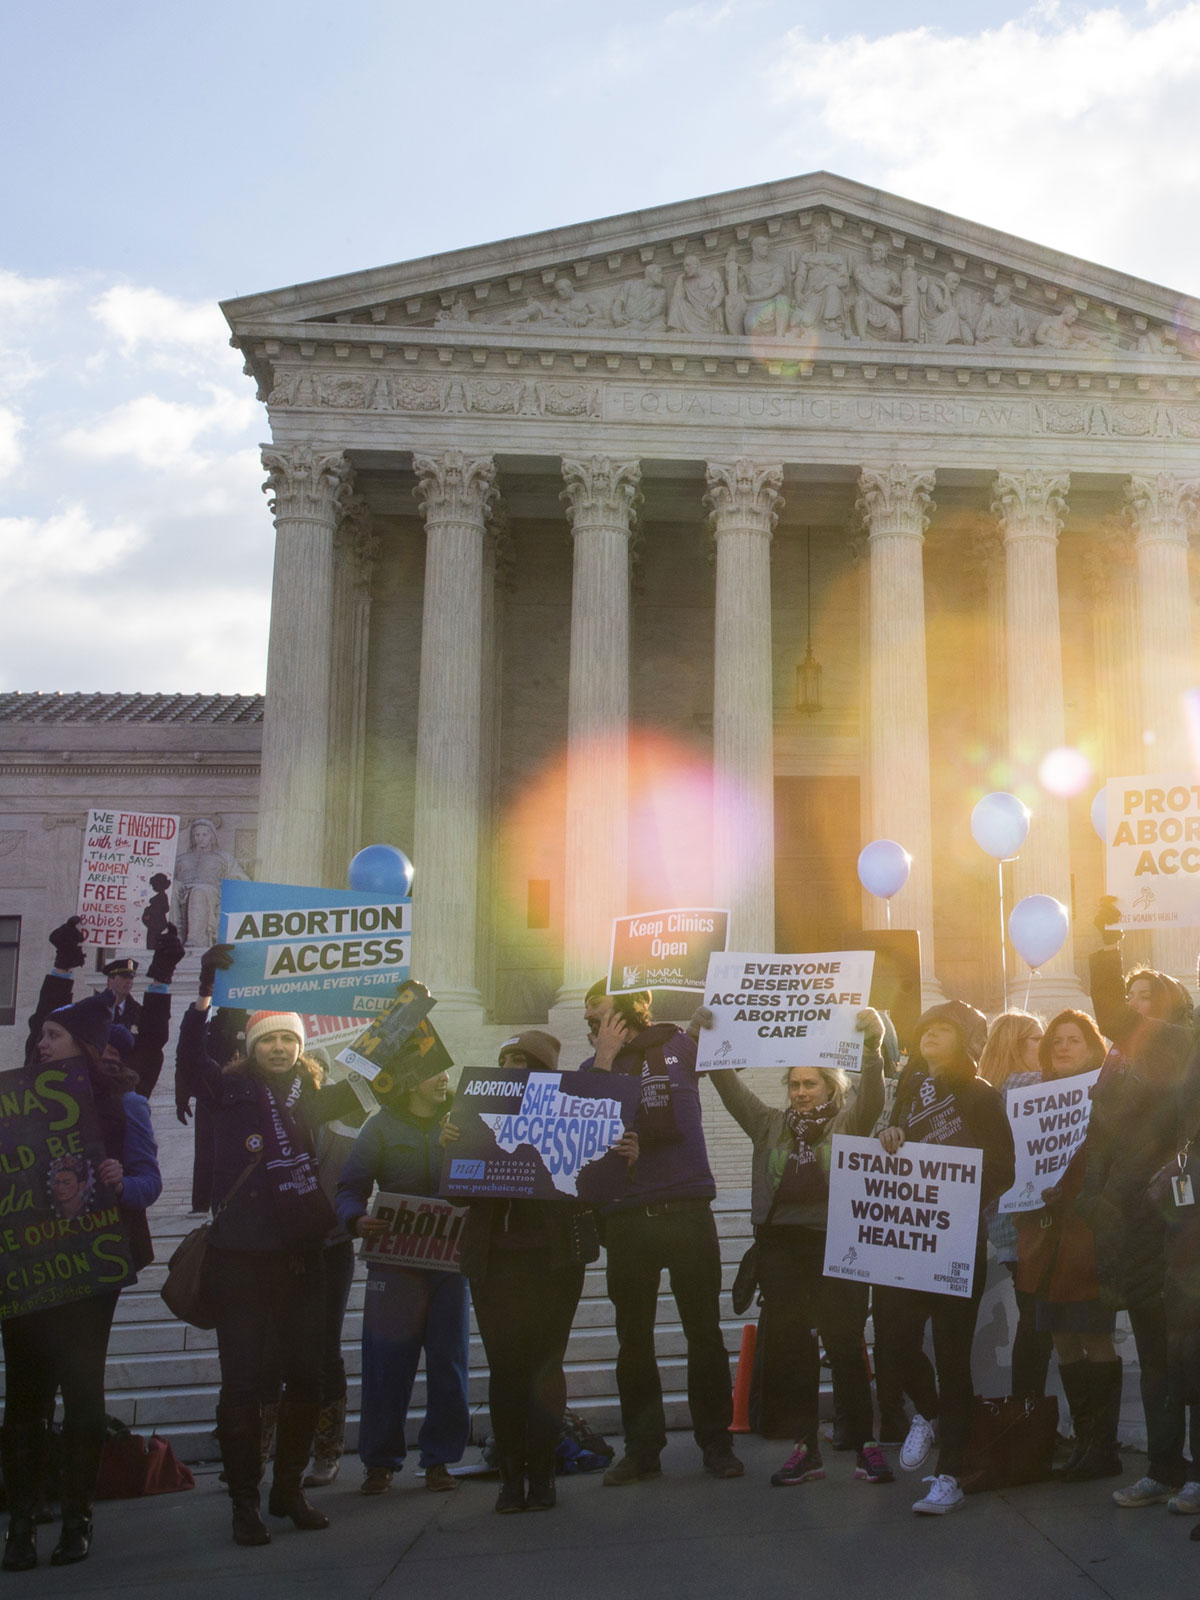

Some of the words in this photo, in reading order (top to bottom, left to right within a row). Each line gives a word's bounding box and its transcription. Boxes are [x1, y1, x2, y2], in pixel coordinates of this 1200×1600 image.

[622, 392, 721, 416] EQUAL
[728, 395, 841, 420] JUSTICE
[856, 401, 953, 425] UNDER
[961, 404, 1015, 425] LAW
[89, 824, 113, 834] ARE
[118, 814, 176, 840] FINISHED
[93, 812, 114, 823] WE
[88, 835, 112, 849] with
[133, 839, 160, 856] LIE
[90, 851, 125, 861] THAT
[87, 873, 128, 885] AREN'T
[83, 883, 127, 901] FREE
[82, 902, 126, 913] UNLESS
[234, 906, 403, 940] ABORTION
[629, 919, 663, 938] Keep
[668, 913, 714, 933] Clinics
[270, 938, 404, 975] ACCESS
[651, 939, 688, 960] Open
[646, 968, 683, 978] NARAL
[743, 961, 842, 975] EVERYONE
[228, 984, 269, 999] EVERY
[270, 980, 320, 994] WOMAN.
[323, 975, 363, 990] EVERY
[363, 972, 402, 986] STATE.
[740, 977, 835, 991] DESERVES
[709, 992, 781, 1006] ACCESS
[785, 993, 810, 1006] TO
[813, 992, 863, 1006] SAFE
[733, 1008, 831, 1022] ABORTION
[757, 1025, 808, 1038] CARE
[839, 1041, 860, 1049] CENTER
[0, 1069, 80, 1131] NAS
[464, 1080, 525, 1097] ABORTION:
[559, 1096, 618, 1120] LEGAL
[1013, 1102, 1019, 1118] I
[1023, 1089, 1083, 1117] STAND
[1038, 1106, 1089, 1133] WHOL
[498, 1115, 620, 1175] ACCESSIBLE
[1026, 1125, 1087, 1156] WOMA
[0, 1144, 36, 1175] LD
[46, 1131, 84, 1158] BE
[488, 1160, 537, 1168] NATIONAL
[1035, 1149, 1073, 1176] HEA
[454, 1161, 482, 1179] naf
[837, 1151, 844, 1169] I
[848, 1152, 913, 1177] STAND
[919, 1159, 976, 1184] WITH
[448, 1183, 534, 1195] www.prochoice.org
[864, 1177, 939, 1204] WHOLE
[851, 1199, 950, 1230] WOMAN'S
[25, 1218, 79, 1247] OUR
[79, 1206, 120, 1233] OWN
[365, 1232, 461, 1262] FEMINI
[857, 1225, 937, 1253] HEALTH
[0, 1233, 129, 1292] CISIONS
[951, 1261, 970, 1271] CENTER
[951, 1268, 960, 1276] FOR
[934, 1274, 969, 1286] REPRODUCTIVE
[949, 1283, 968, 1293] RIGHTS
